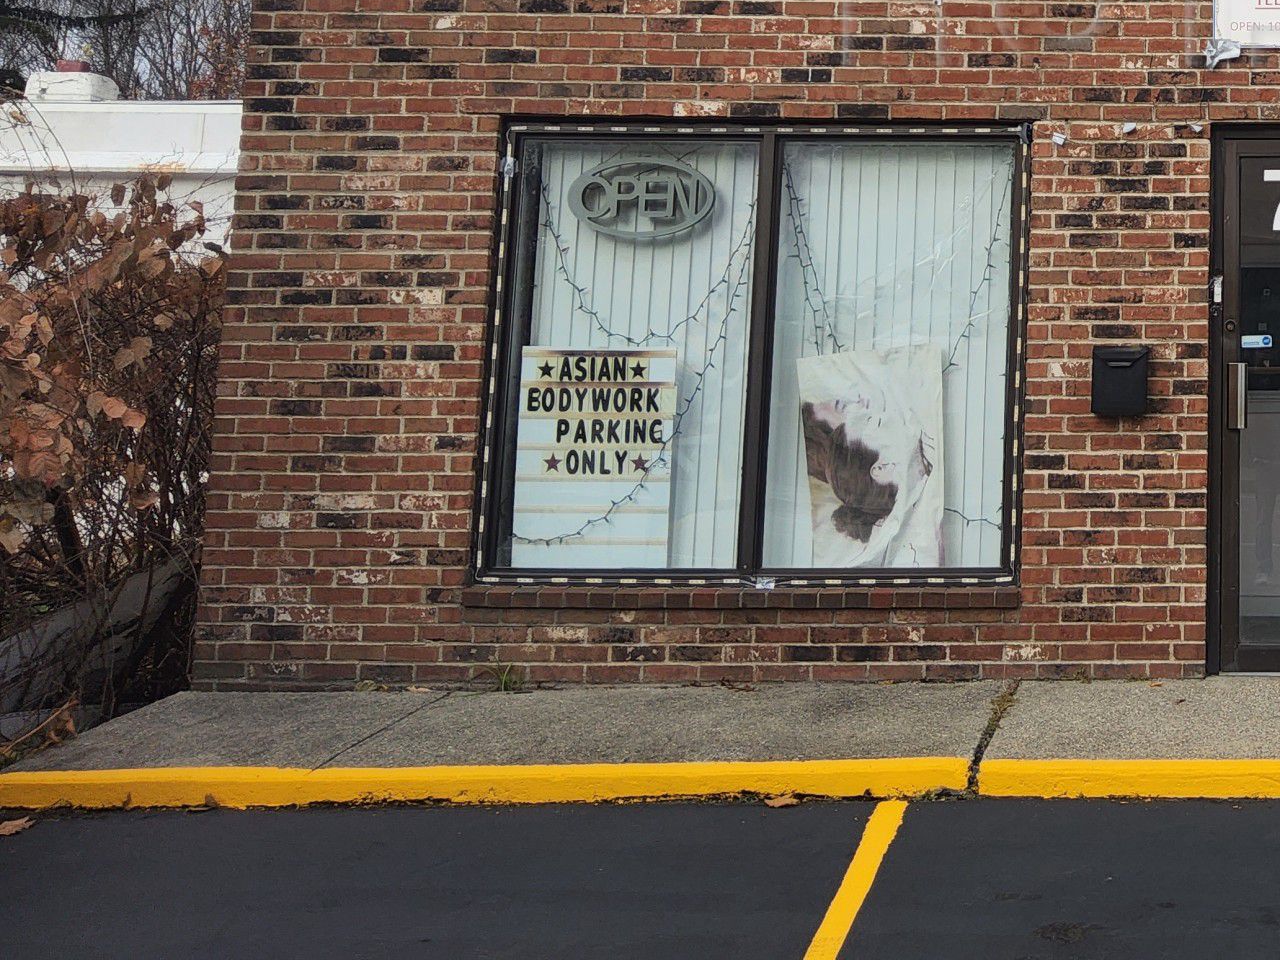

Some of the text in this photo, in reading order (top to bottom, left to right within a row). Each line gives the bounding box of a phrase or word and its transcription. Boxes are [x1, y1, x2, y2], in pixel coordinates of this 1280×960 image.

[1230, 21, 1265, 32] OPEN:
[576, 175, 702, 219] OPEN
[559, 356, 627, 382] ASIAN
[527, 387, 660, 413] BODYWORK
[556, 418, 663, 444] PARKING
[566, 449, 629, 475] ONLY
